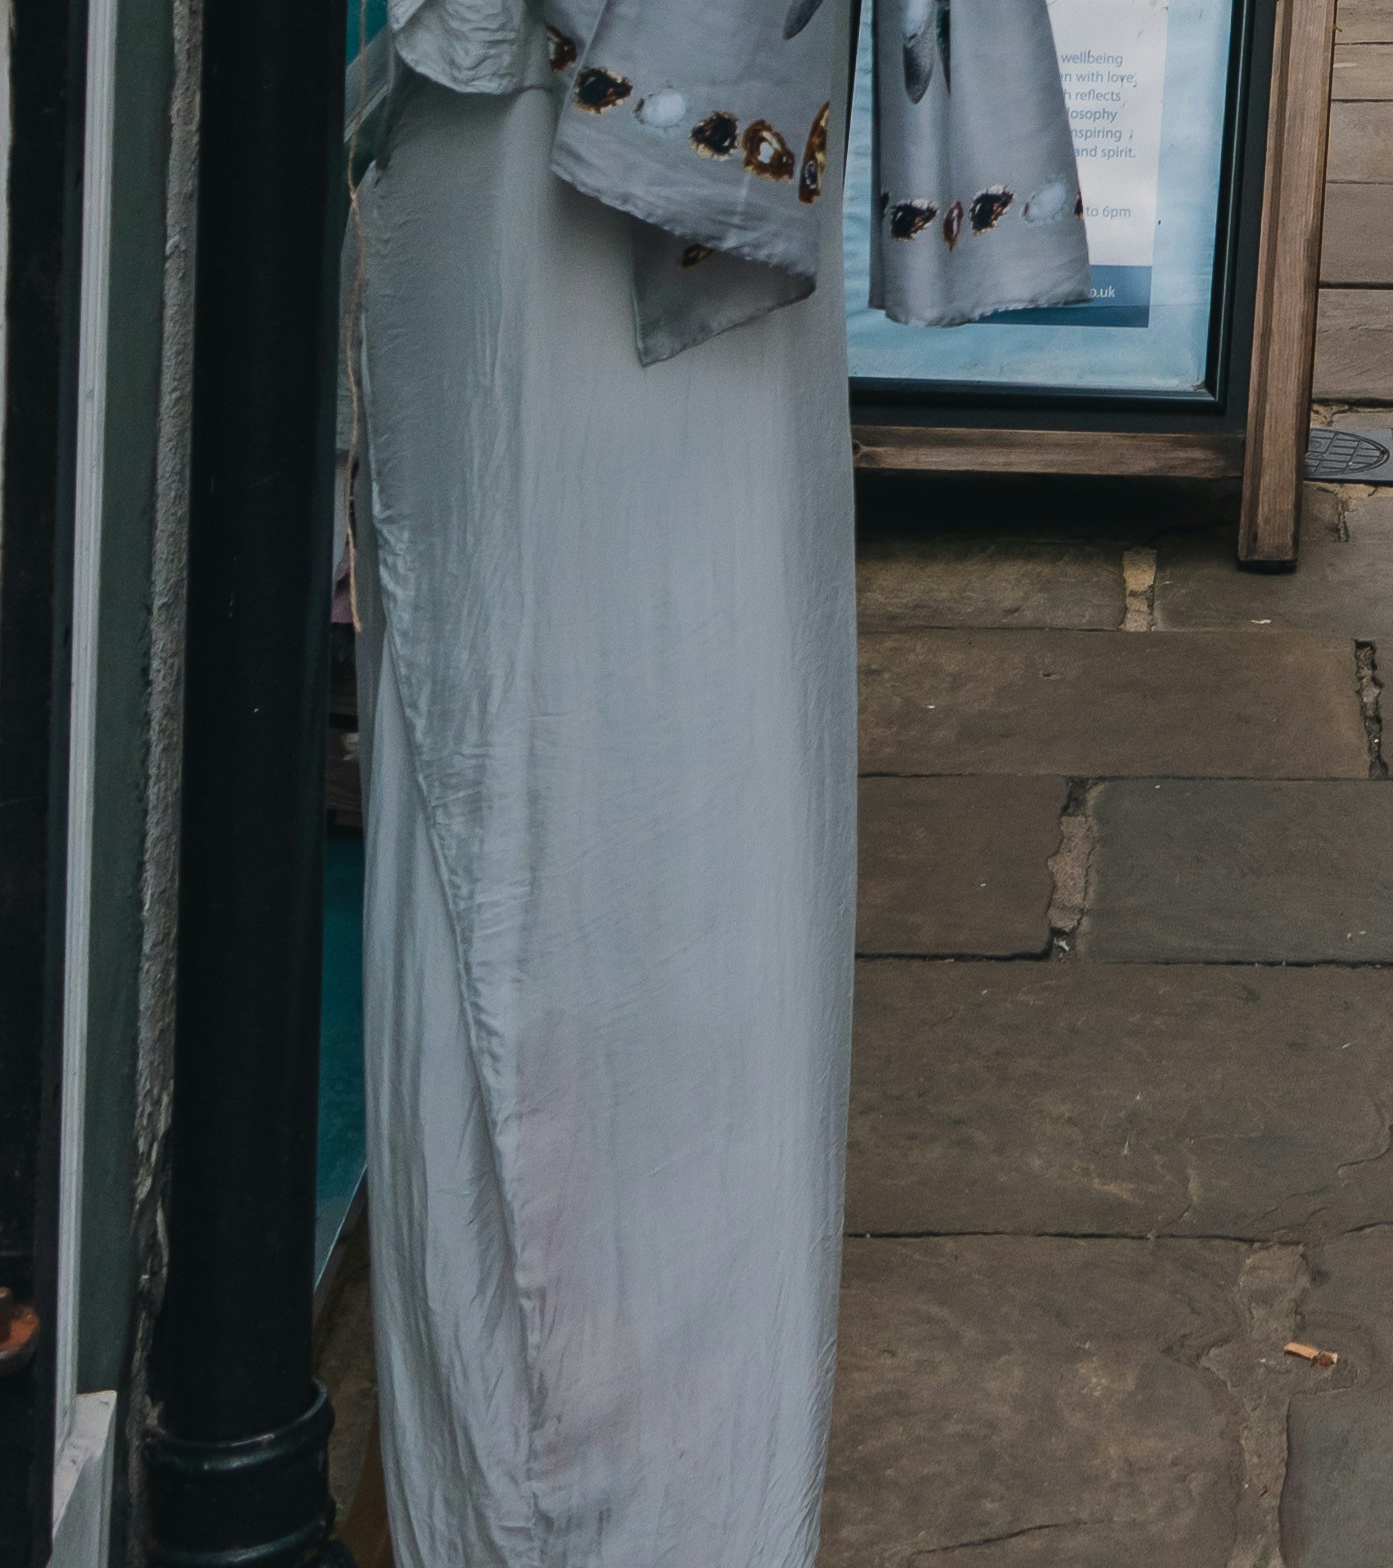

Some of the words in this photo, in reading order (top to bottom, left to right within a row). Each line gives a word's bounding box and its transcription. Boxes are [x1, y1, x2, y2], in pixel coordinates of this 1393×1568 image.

[1061, 50, 1124, 68] wellbeing
[1076, 71, 1104, 83] with
[1075, 88, 1122, 102] reflects
[1101, 146, 1136, 160] spirit.
[1102, 205, 1132, 219] 6pm
